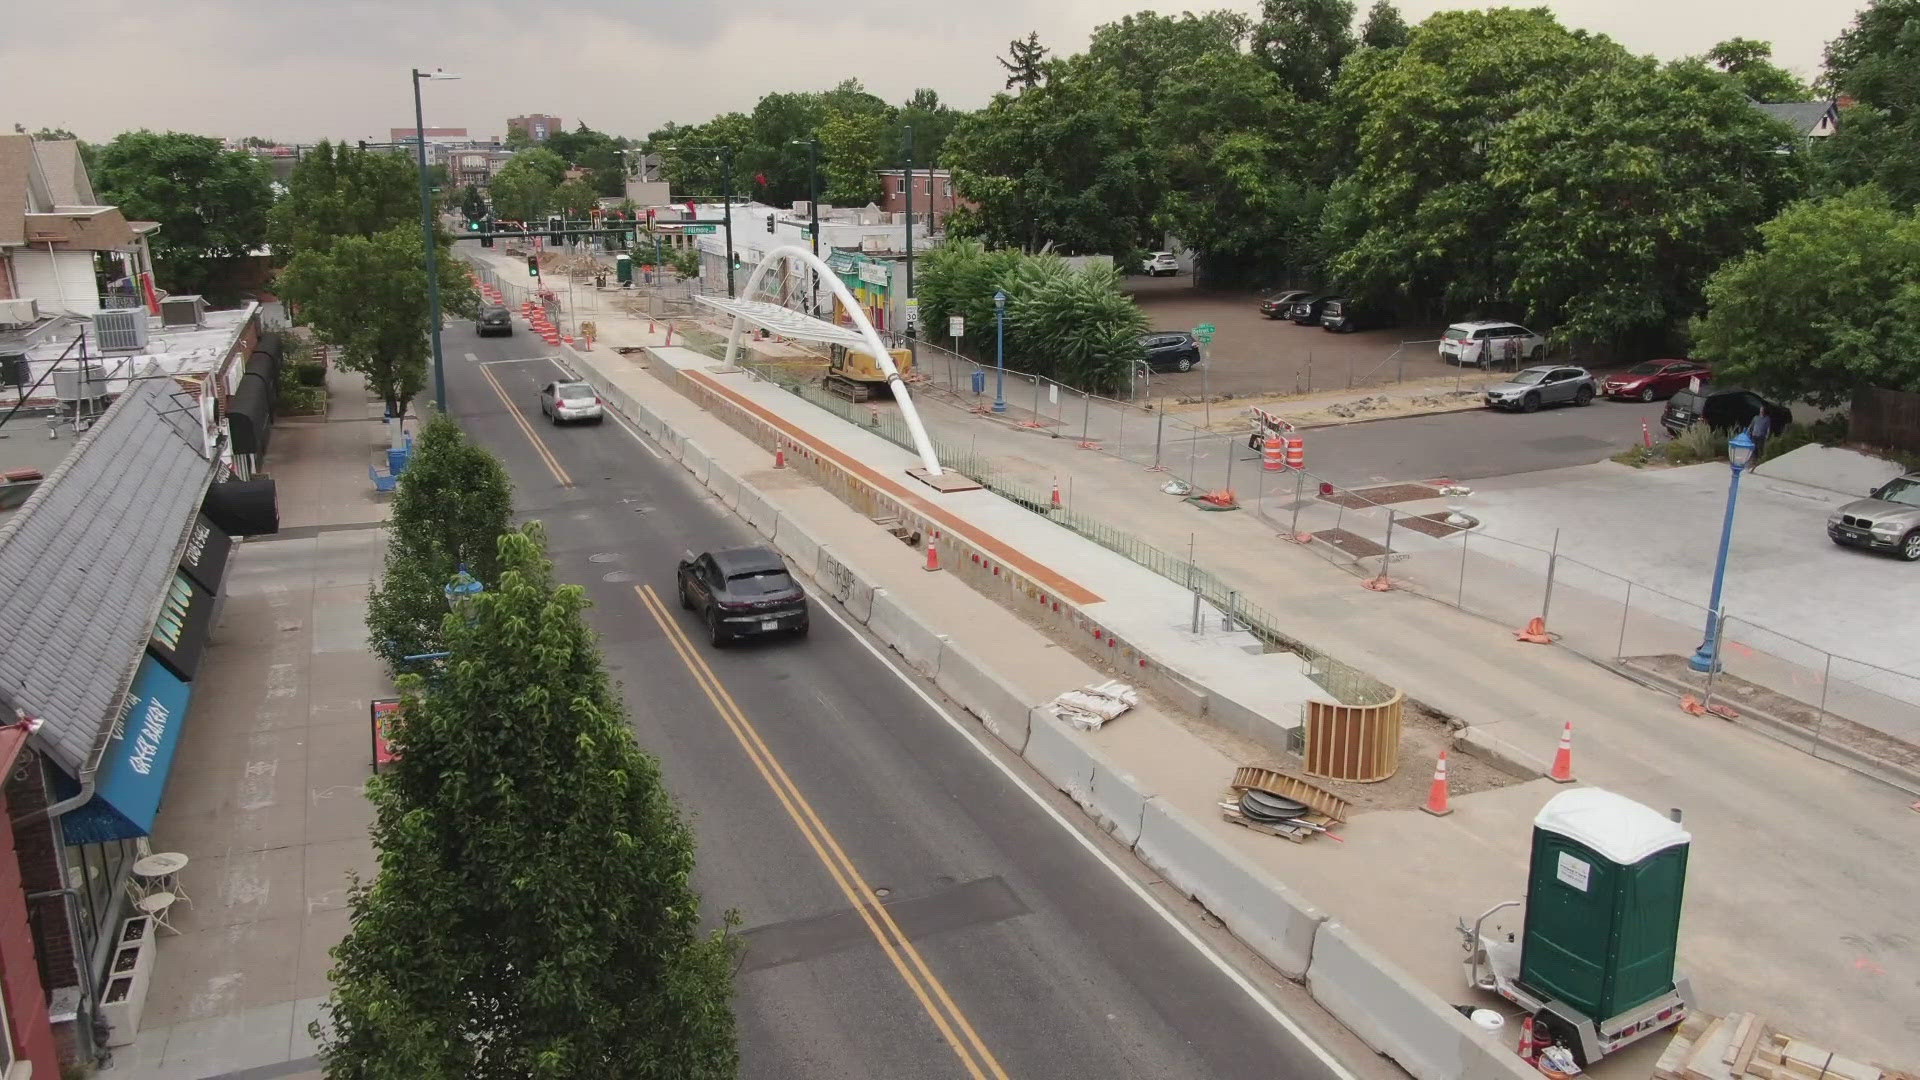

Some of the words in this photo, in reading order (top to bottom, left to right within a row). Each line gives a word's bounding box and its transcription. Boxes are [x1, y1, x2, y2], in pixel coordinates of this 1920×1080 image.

[906, 313, 917, 321] 30
[152, 574, 193, 652] TATTOO
[141, 696, 170, 745] BAKERY
